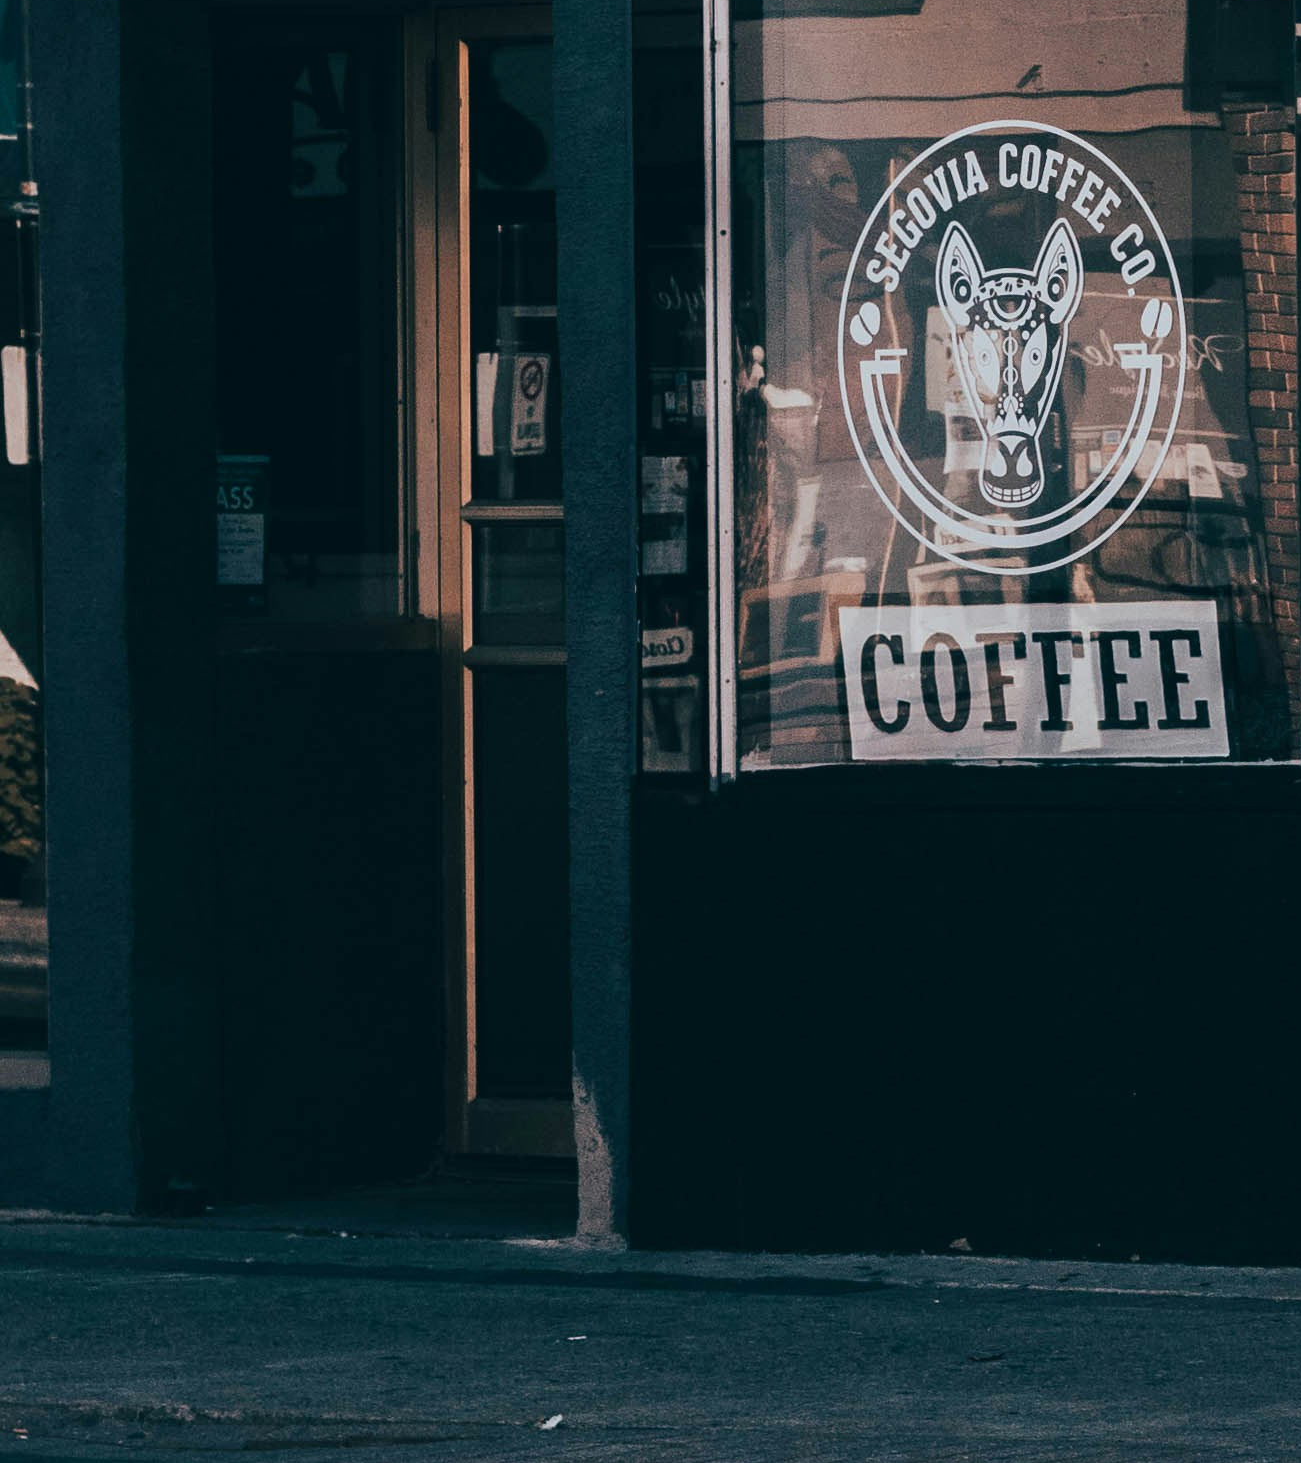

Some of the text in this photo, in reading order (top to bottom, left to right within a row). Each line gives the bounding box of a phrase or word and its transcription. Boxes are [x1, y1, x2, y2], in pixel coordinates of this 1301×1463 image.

[865, 150, 989, 294] SEGOVIA
[998, 142, 1122, 235] COFFEE
[859, 628, 1212, 736] COFFEE
